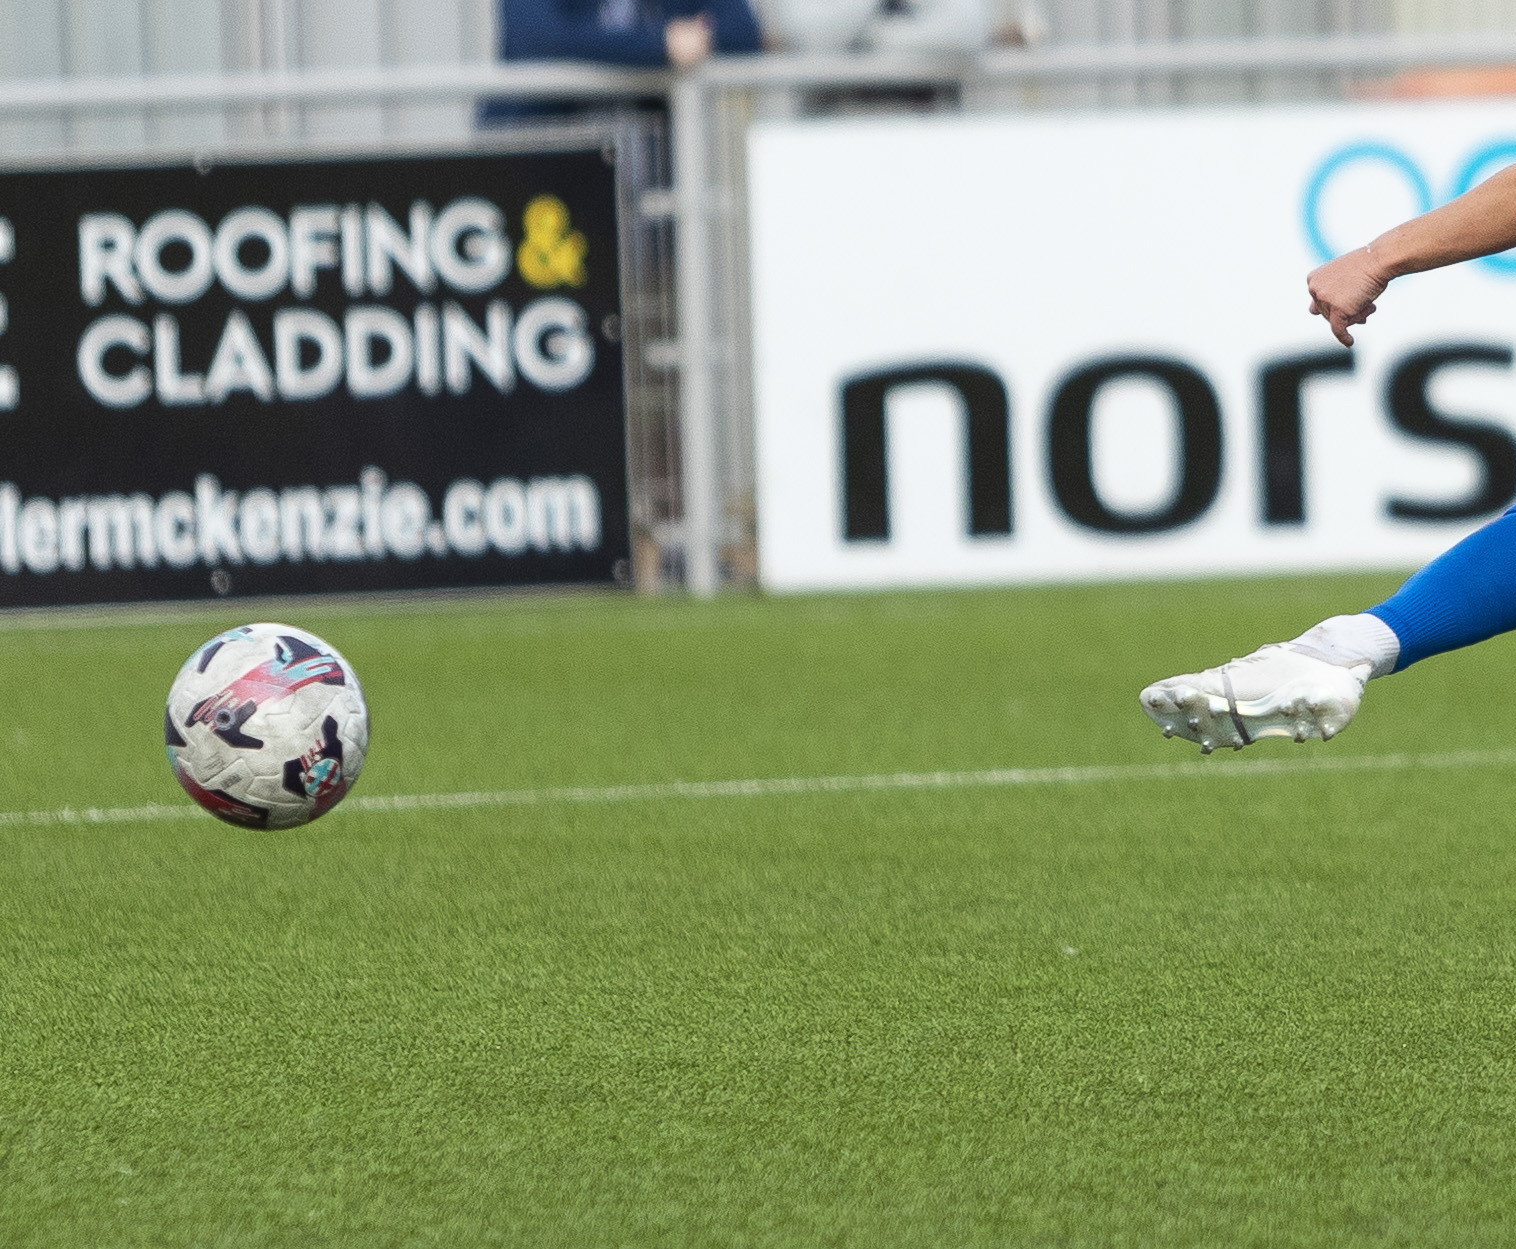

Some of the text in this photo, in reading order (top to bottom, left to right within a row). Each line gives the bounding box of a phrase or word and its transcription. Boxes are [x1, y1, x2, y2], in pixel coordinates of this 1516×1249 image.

[77, 195, 587, 306] ROOFING &
[77, 298, 596, 408] CLADDING
